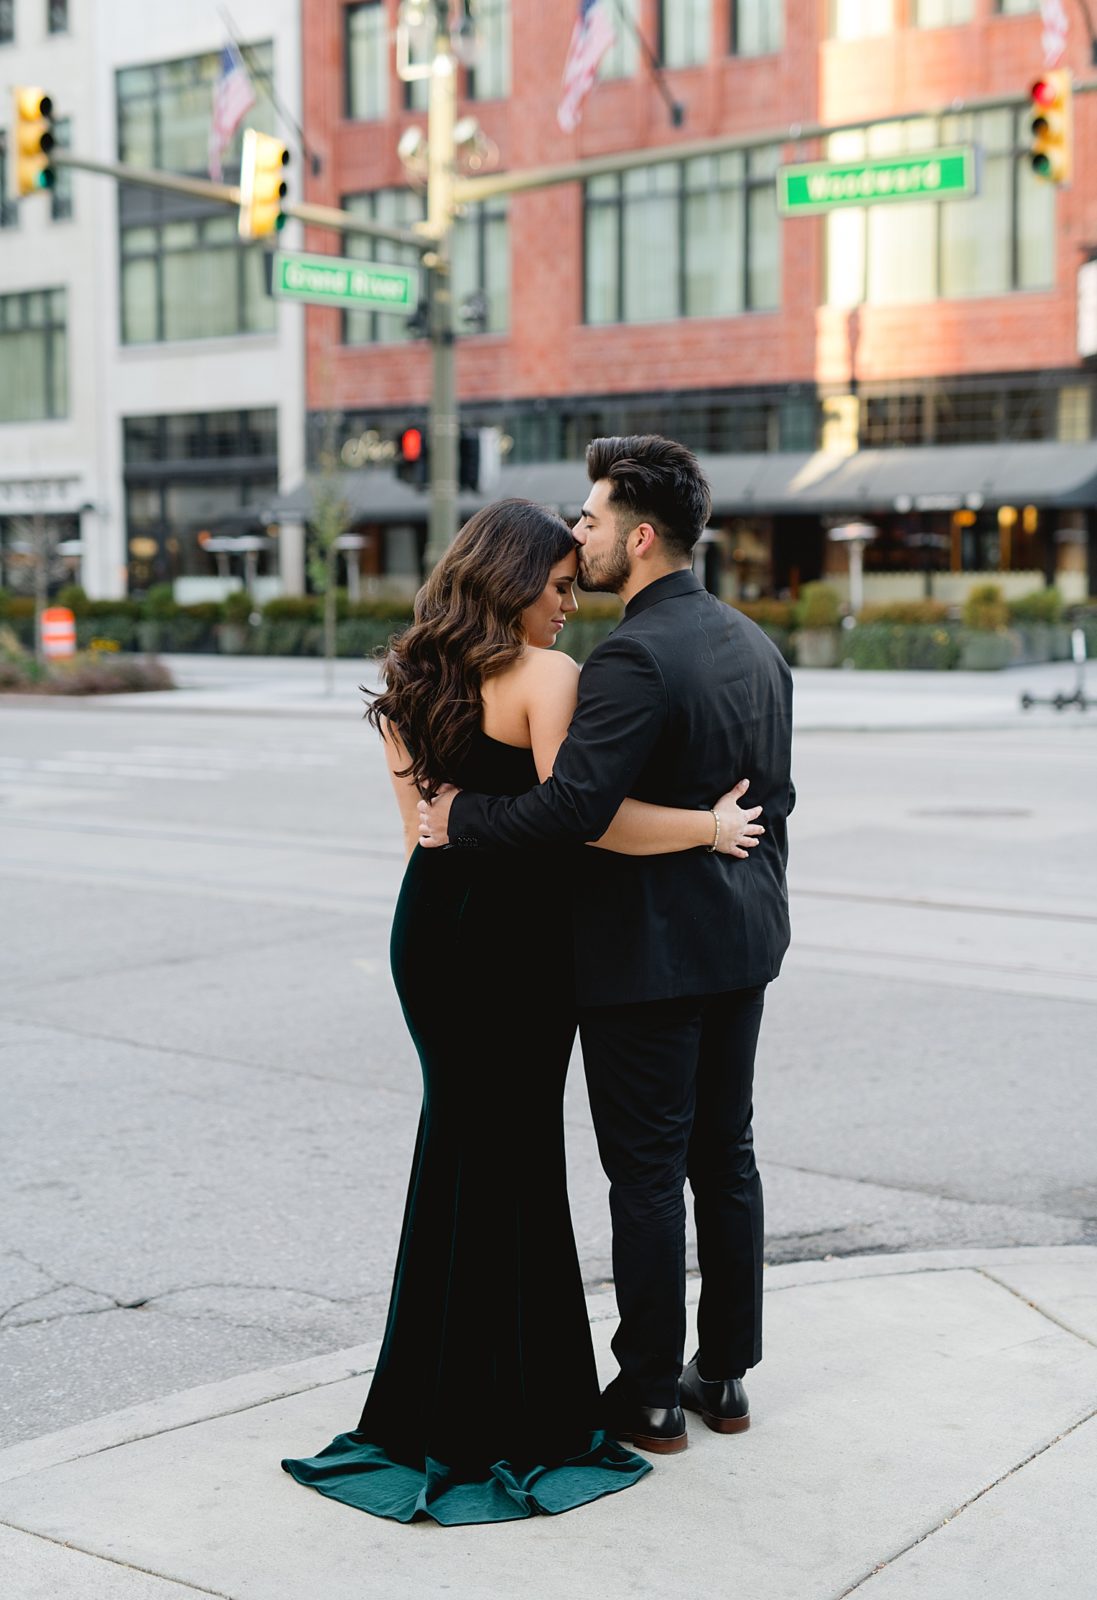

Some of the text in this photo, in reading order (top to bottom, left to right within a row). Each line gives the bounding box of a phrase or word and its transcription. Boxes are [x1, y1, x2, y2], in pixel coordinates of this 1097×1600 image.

[806, 160, 941, 201] Woodward
[285, 262, 405, 302] Grand River
